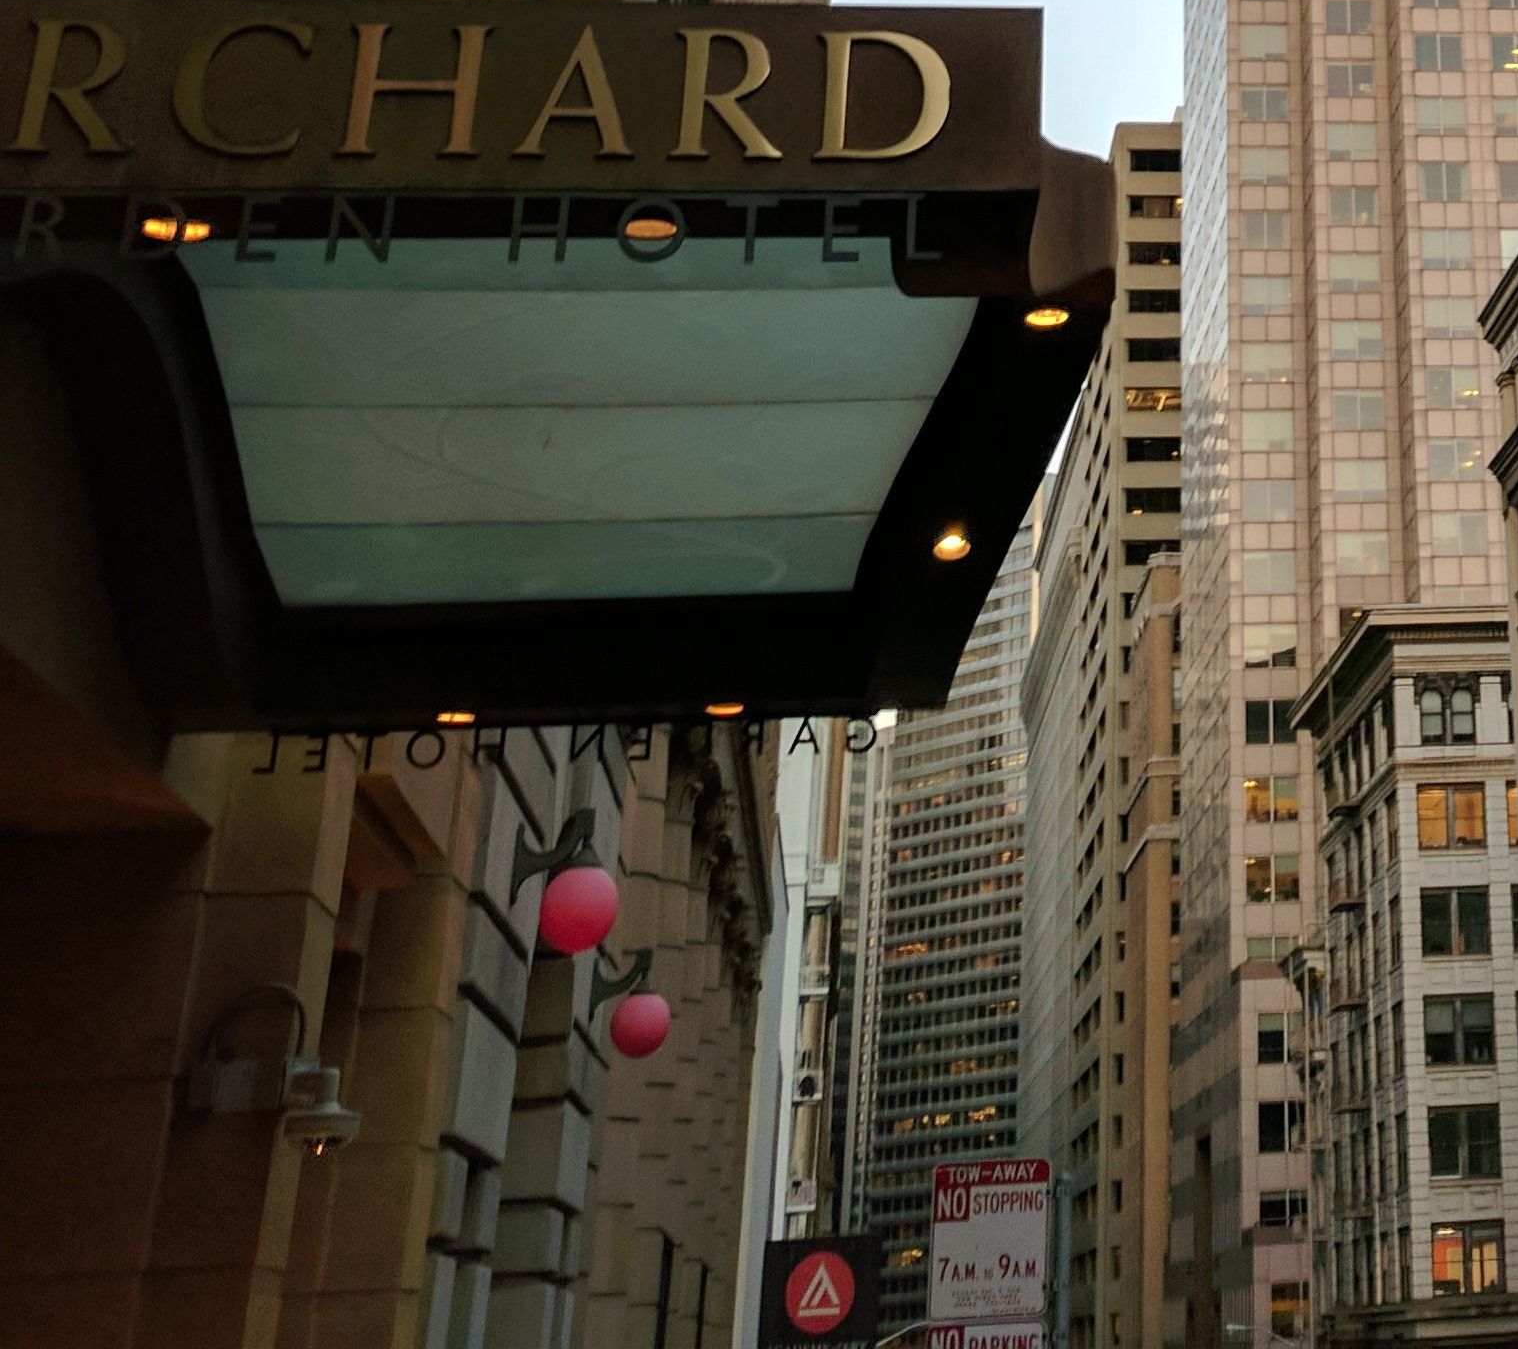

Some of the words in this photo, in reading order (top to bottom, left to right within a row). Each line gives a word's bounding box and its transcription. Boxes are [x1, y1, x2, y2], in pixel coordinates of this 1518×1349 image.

[4, 18, 953, 163] RCHARD
[507, 191, 943, 264] HOTEL
[947, 1162, 1038, 1186] TOW-AWAY
[936, 1186, 968, 1221] NO
[973, 1189, 1044, 1215] STOPPING
[931, 1327, 961, 1349] NO
